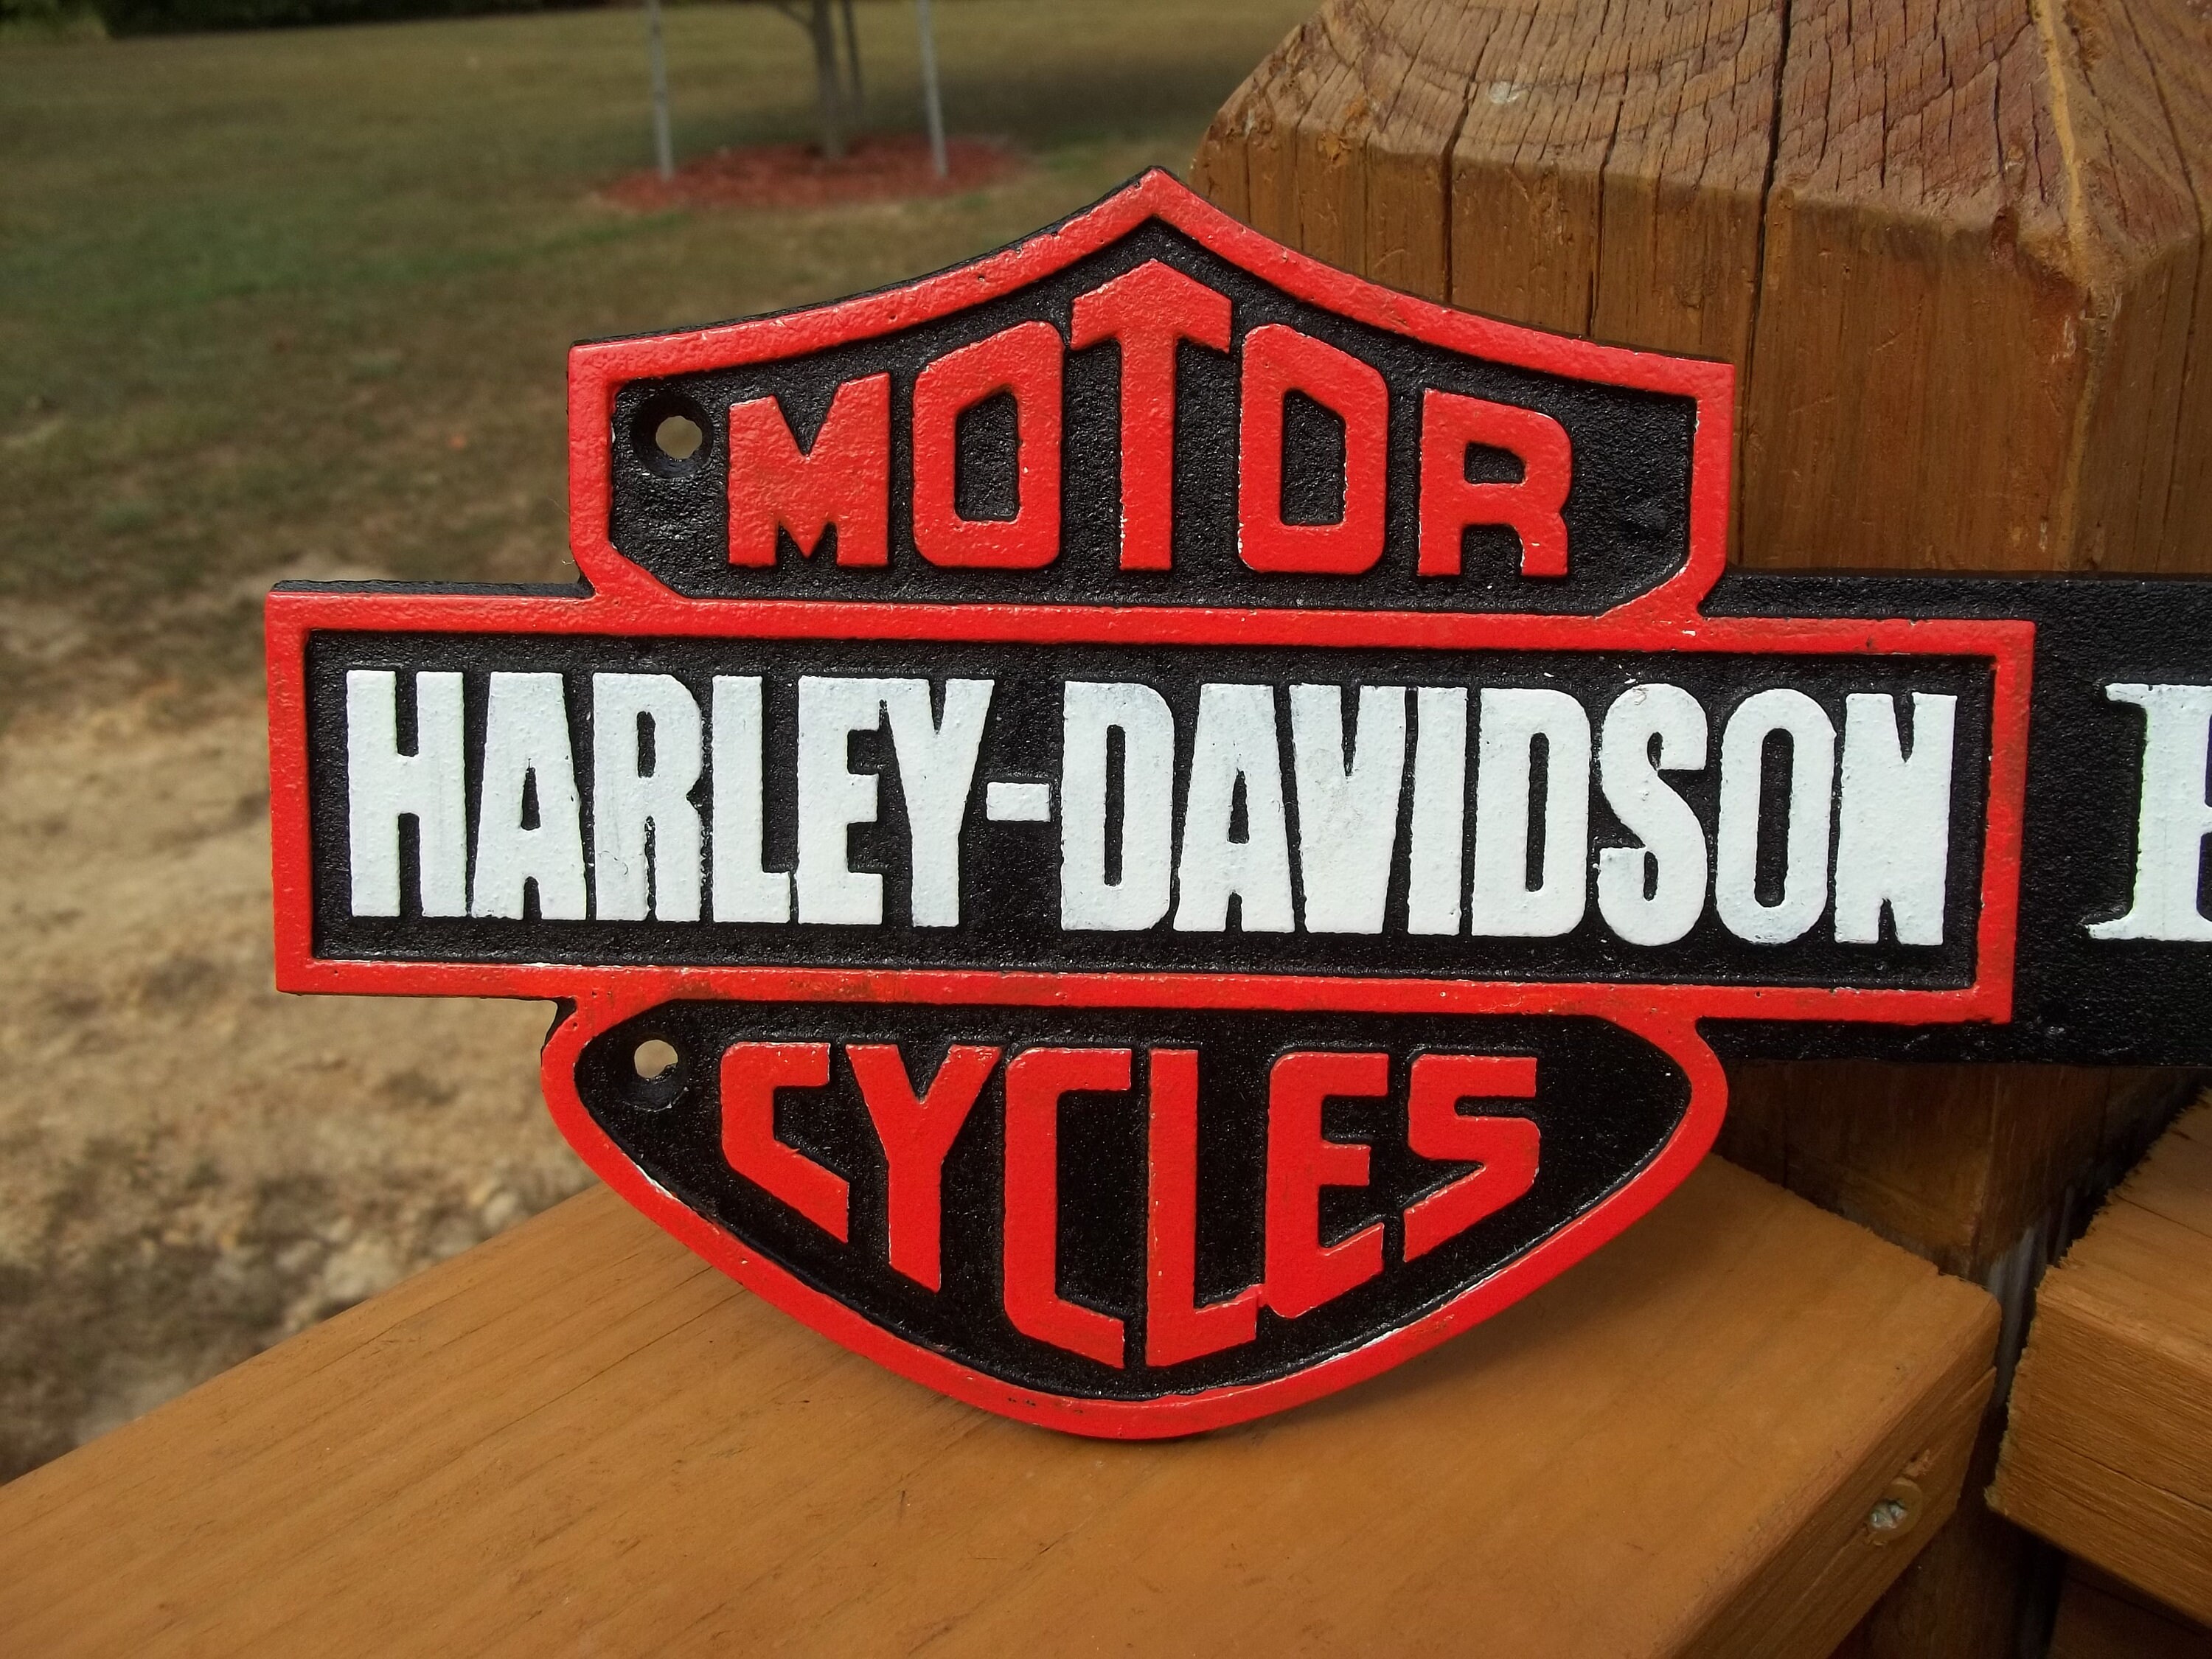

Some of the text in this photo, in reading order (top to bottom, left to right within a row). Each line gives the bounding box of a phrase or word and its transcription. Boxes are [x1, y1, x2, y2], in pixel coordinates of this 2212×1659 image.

[726, 259, 1573, 577] MOTOR
[344, 669, 1959, 947] HARLEY-DAVIDSON
[719, 1040, 1542, 1370] CYCLES
